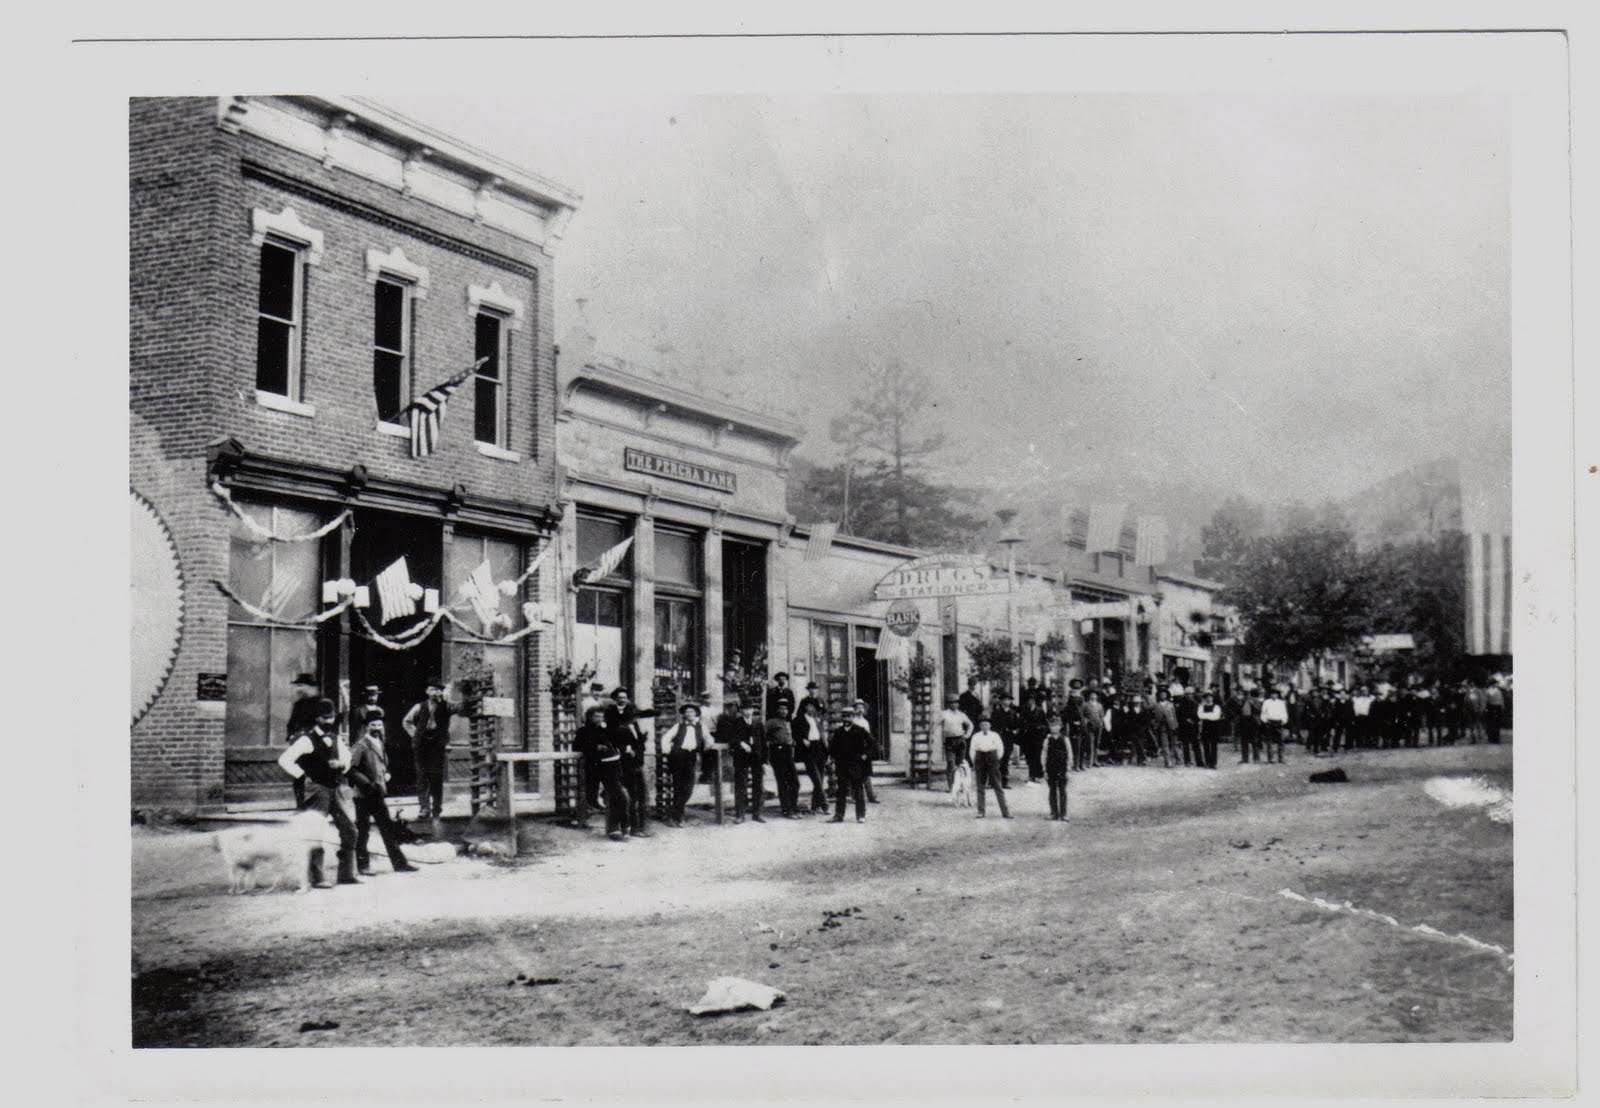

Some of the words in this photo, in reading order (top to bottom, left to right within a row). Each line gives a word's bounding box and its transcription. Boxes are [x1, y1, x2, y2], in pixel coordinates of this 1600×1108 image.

[628, 453, 652, 469] THE
[703, 470, 734, 488] BANK
[887, 611, 919, 625] BANK
